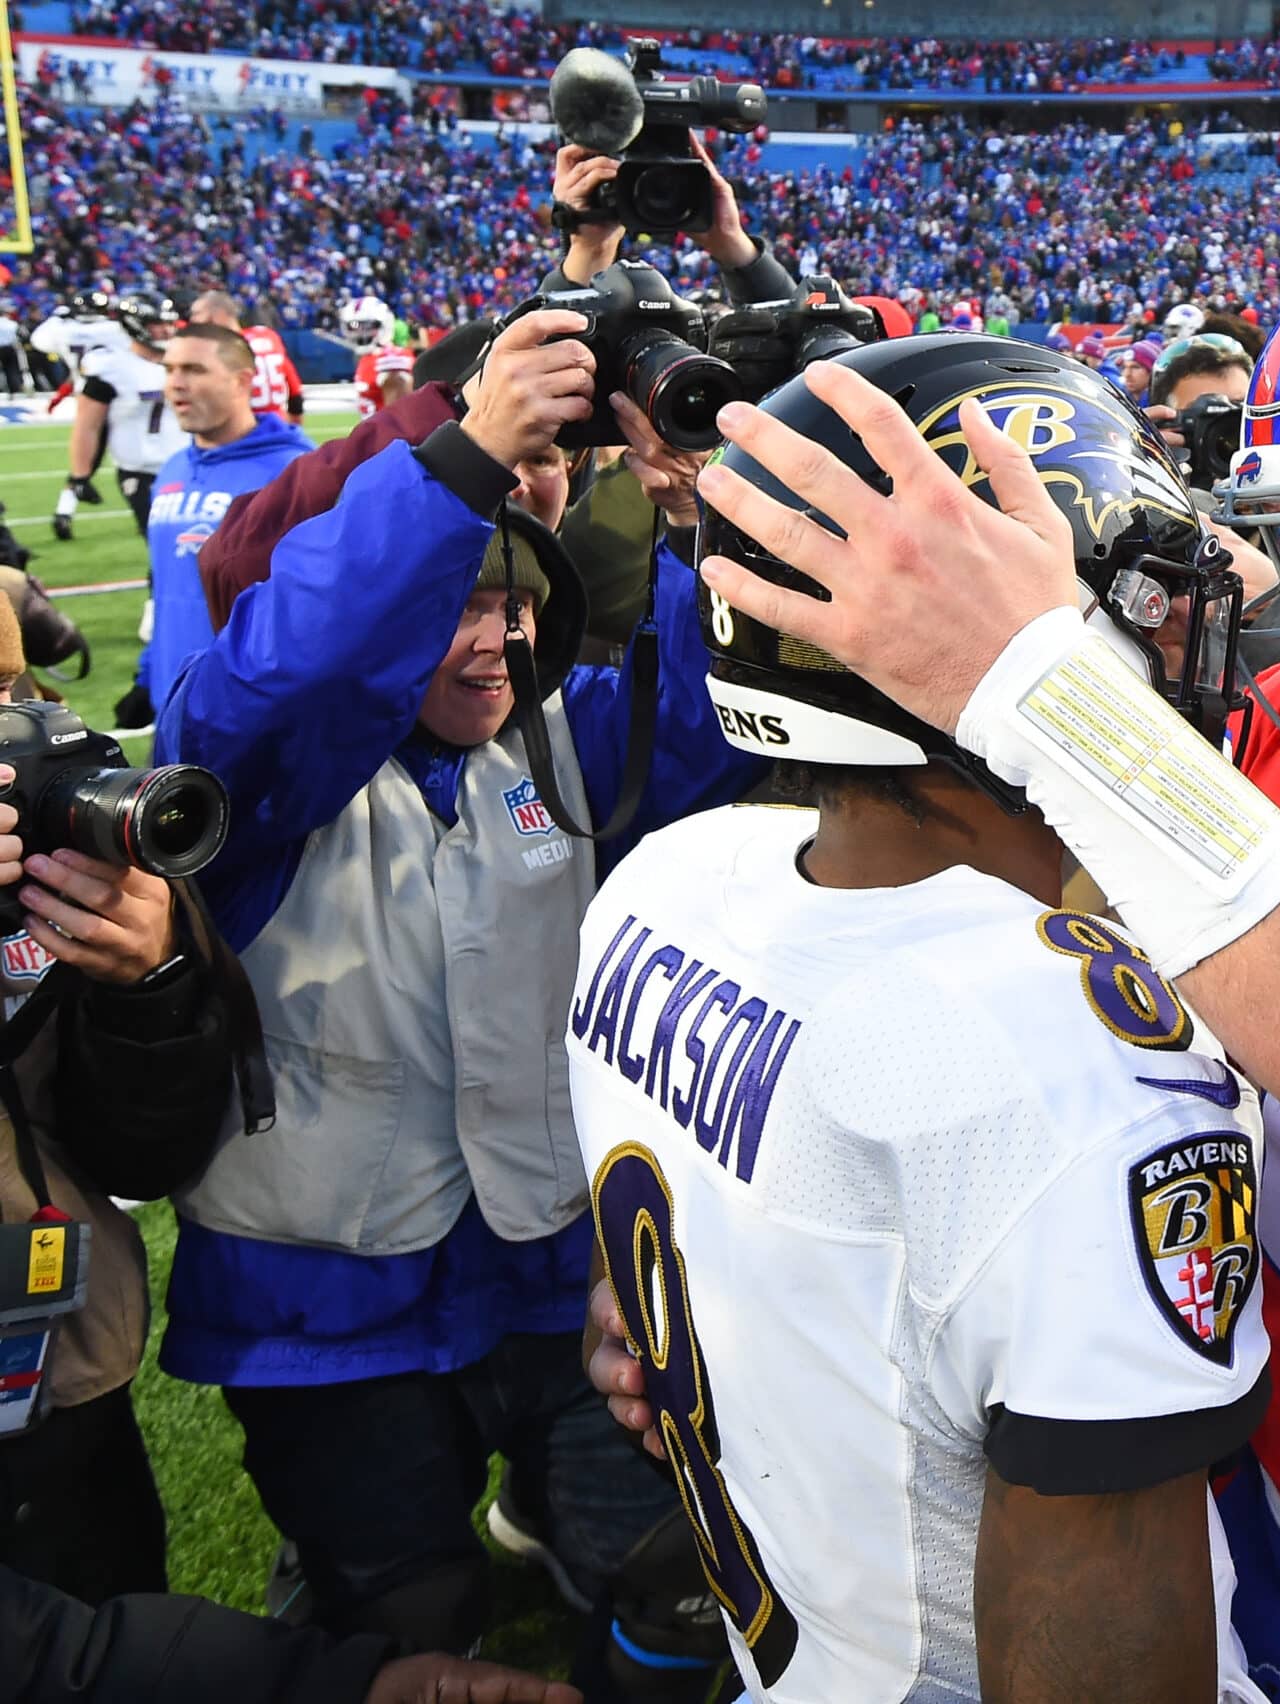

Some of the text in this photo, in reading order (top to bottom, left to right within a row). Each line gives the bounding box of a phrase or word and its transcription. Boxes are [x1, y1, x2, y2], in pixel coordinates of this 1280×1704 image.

[248, 66, 309, 89] FREY
[639, 300, 671, 310] Canon
[812, 302, 840, 311] Canon
[51, 730, 88, 745] Canon
[514, 801, 555, 830] NF
[4, 937, 55, 971] NF
[1035, 908, 1194, 1052] 8
[572, 914, 802, 1184] JACKSON
[1140, 1142, 1248, 1188] RAVENS
[1147, 1178, 1213, 1254] B
[592, 1139, 799, 1692] 8
